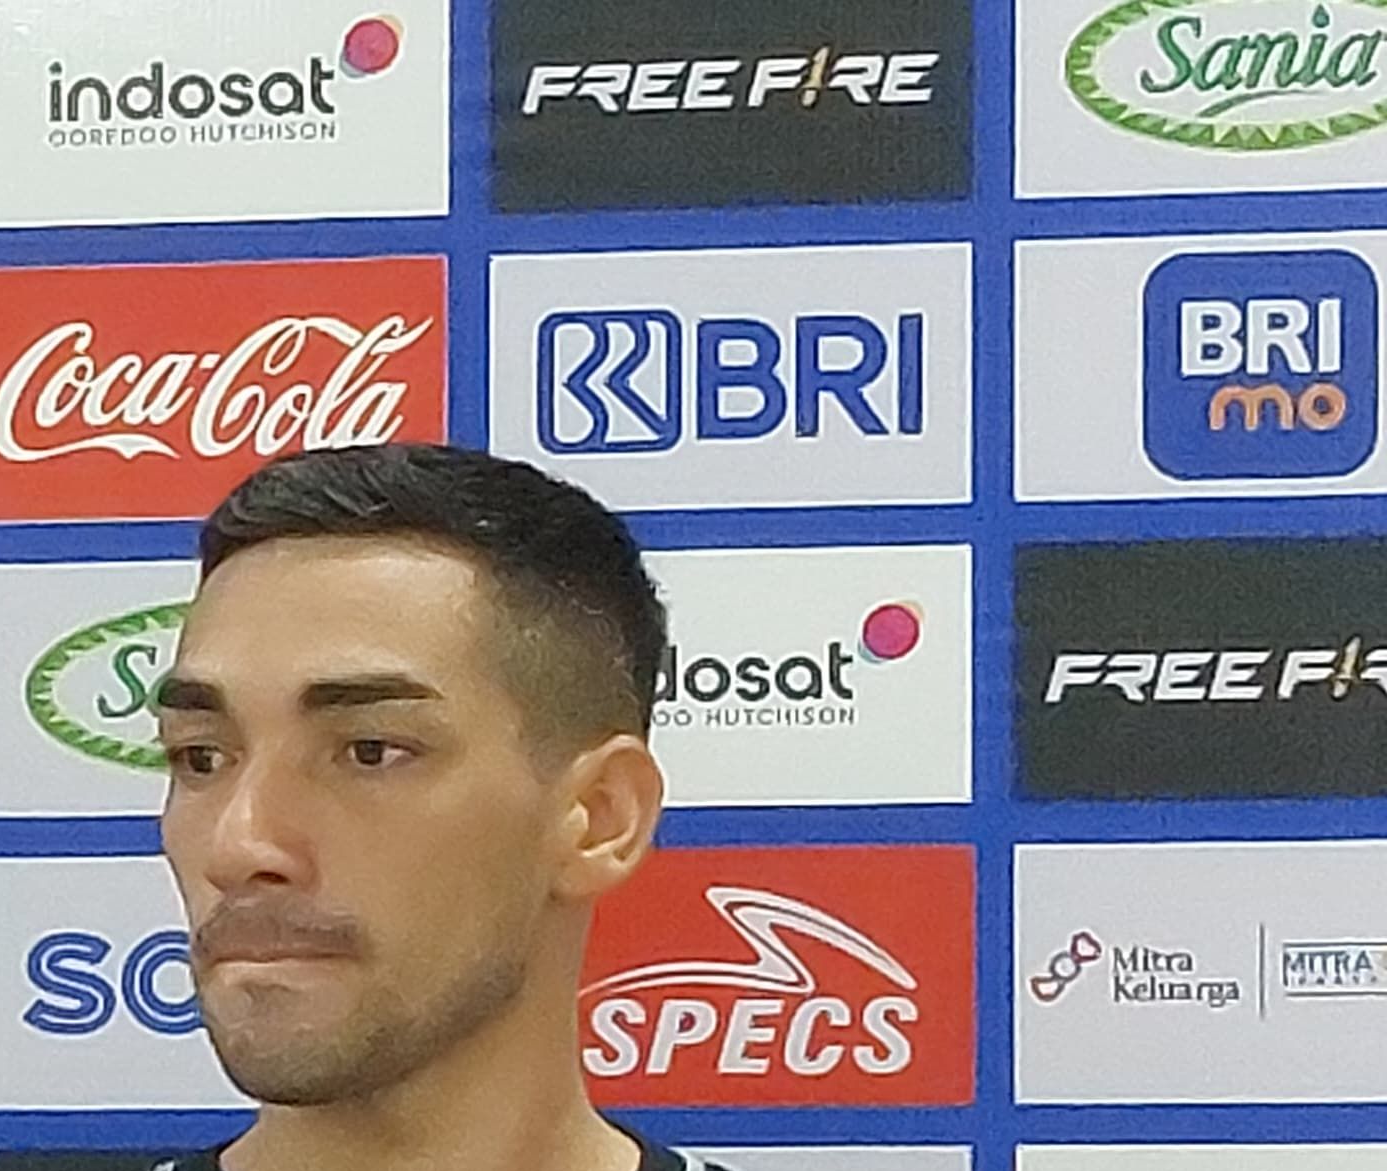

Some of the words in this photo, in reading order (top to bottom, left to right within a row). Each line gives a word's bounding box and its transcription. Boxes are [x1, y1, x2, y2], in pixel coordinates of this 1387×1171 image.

[1141, 4, 1382, 92] Sania
[49, 57, 334, 121] indosat
[522, 58, 737, 114] FREE
[49, 126, 176, 147] OOREDOO
[190, 122, 336, 143] HUTCHISON
[1180, 298, 1342, 375] BRI
[696, 314, 925, 440] BRI
[1209, 383, 1346, 431] mo
[655, 642, 853, 702] dosat
[1044, 651, 1271, 702] FREE
[705, 706, 854, 726] HUTCHISON
[1113, 946, 1194, 973] Mitra
[1113, 976, 1240, 1007] Keluarga
[582, 998, 918, 1078] SPECS
